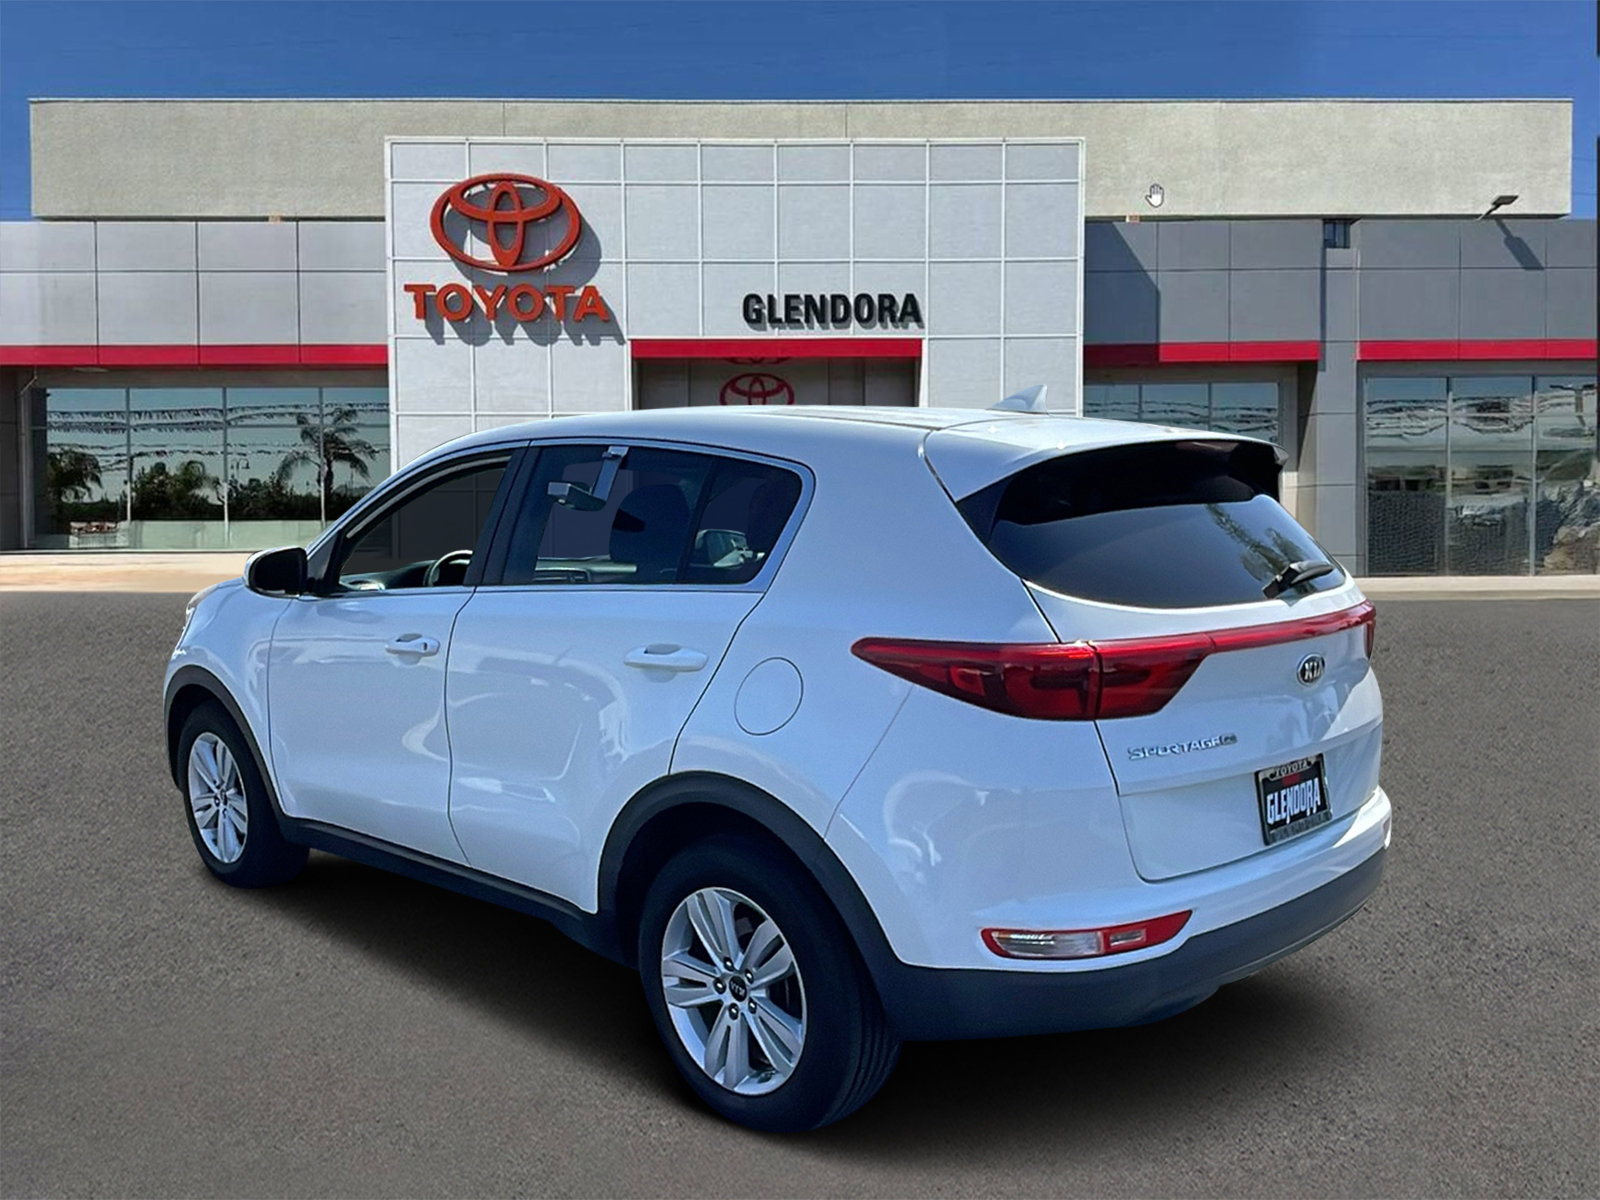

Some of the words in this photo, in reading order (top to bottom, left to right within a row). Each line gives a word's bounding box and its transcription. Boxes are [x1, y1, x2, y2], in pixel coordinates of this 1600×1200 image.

[404, 283, 610, 321] TOYOTA
[743, 293, 922, 324] GLENDORA
[1128, 737, 1221, 761] SPORTAGE
[1273, 760, 1310, 777] TOYOTA
[1266, 777, 1321, 825] GLENDORA
